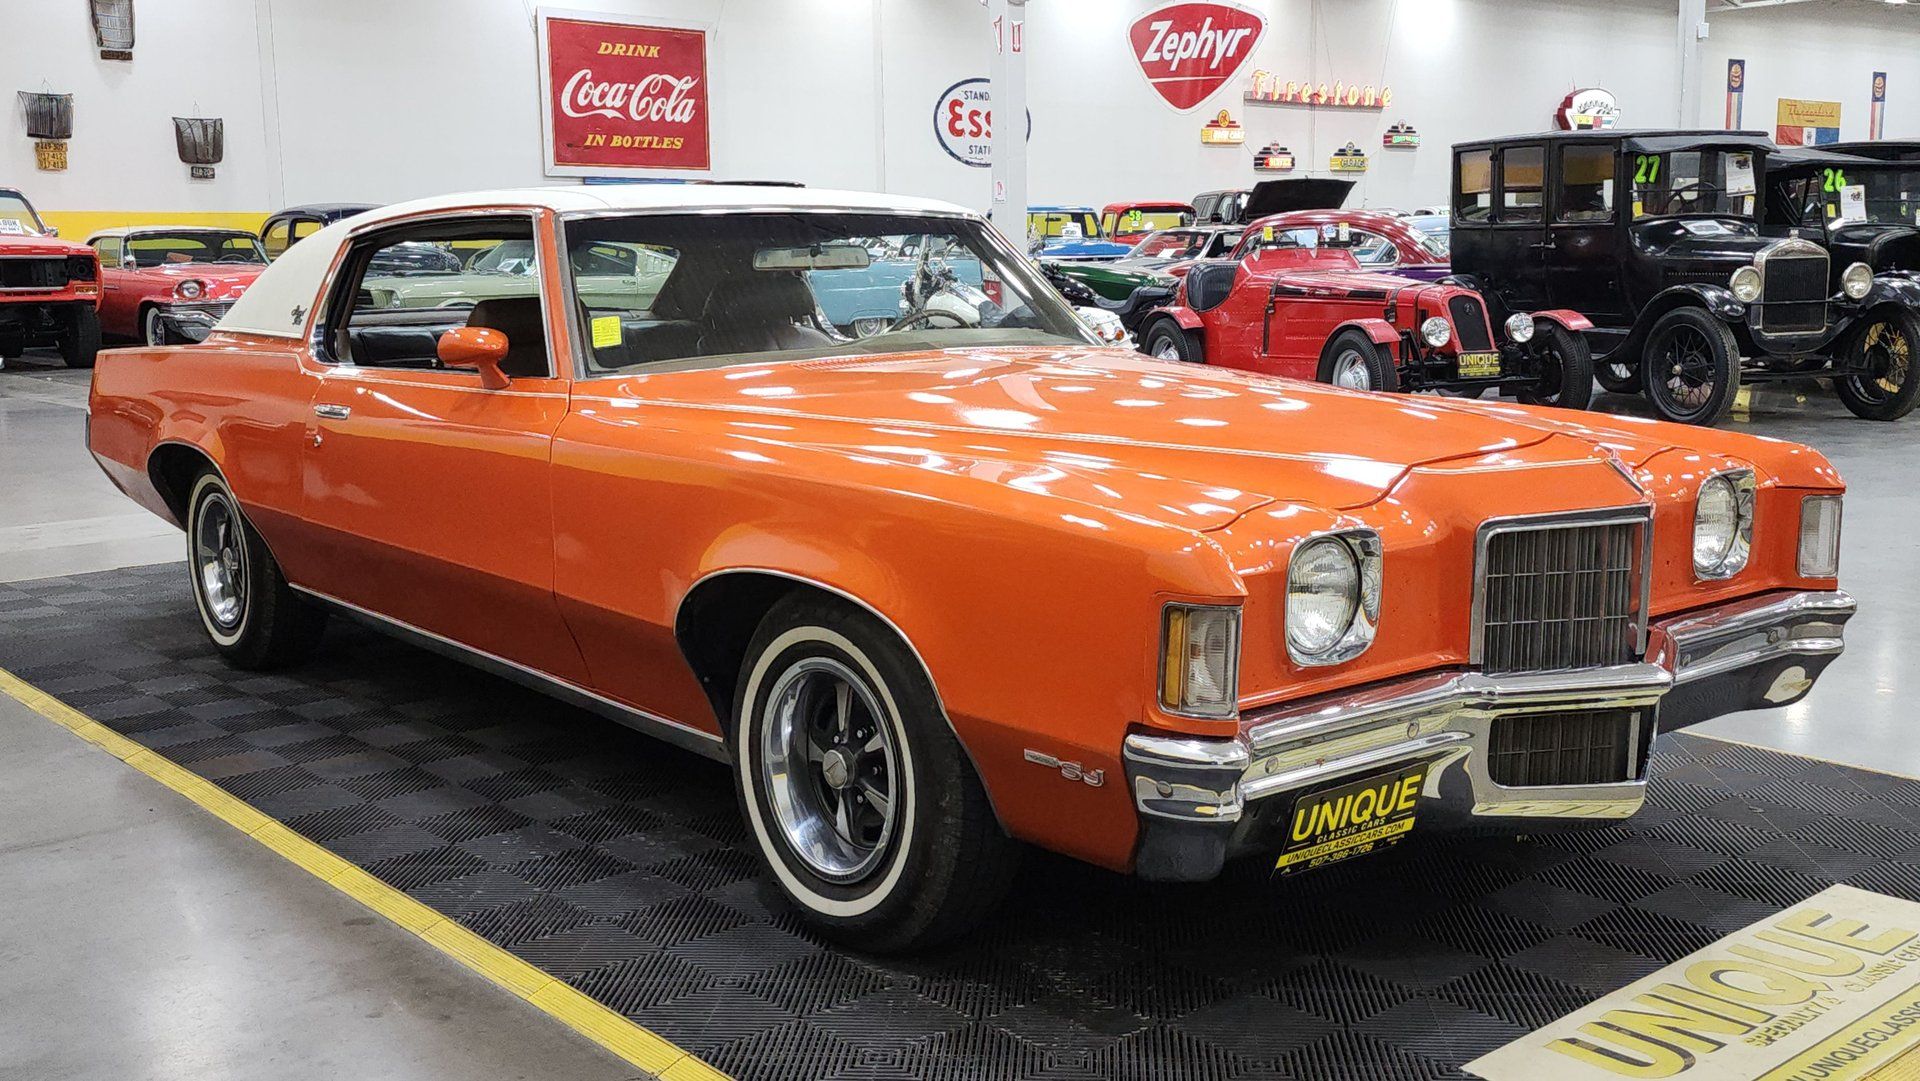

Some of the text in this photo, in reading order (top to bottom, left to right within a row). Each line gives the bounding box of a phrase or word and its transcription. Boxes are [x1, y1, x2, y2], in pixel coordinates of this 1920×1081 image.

[597, 41, 661, 58] DRINK
[1141, 16, 1251, 70] Zephyr
[560, 68, 700, 124] Coca-Cola
[963, 89, 991, 101] STAND
[1252, 69, 1393, 107] Firestone
[584, 133, 684, 149] IN BOTTLES
[1634, 154, 1661, 184] 27
[1823, 167, 1847, 193] 26
[1128, 209, 1143, 221] 58
[1459, 353, 1500, 366] UNIQUE
[1061, 760, 1105, 788] SJ
[1292, 774, 1422, 842] UNIQUE
[1286, 821, 1406, 864] UNIQUECLASSICCARS.COM
[1316, 816, 1386, 844] CLASSIC CARS
[1843, 958, 1907, 993] CLASSIC
[1544, 907, 1920, 1079] UNIQUE
